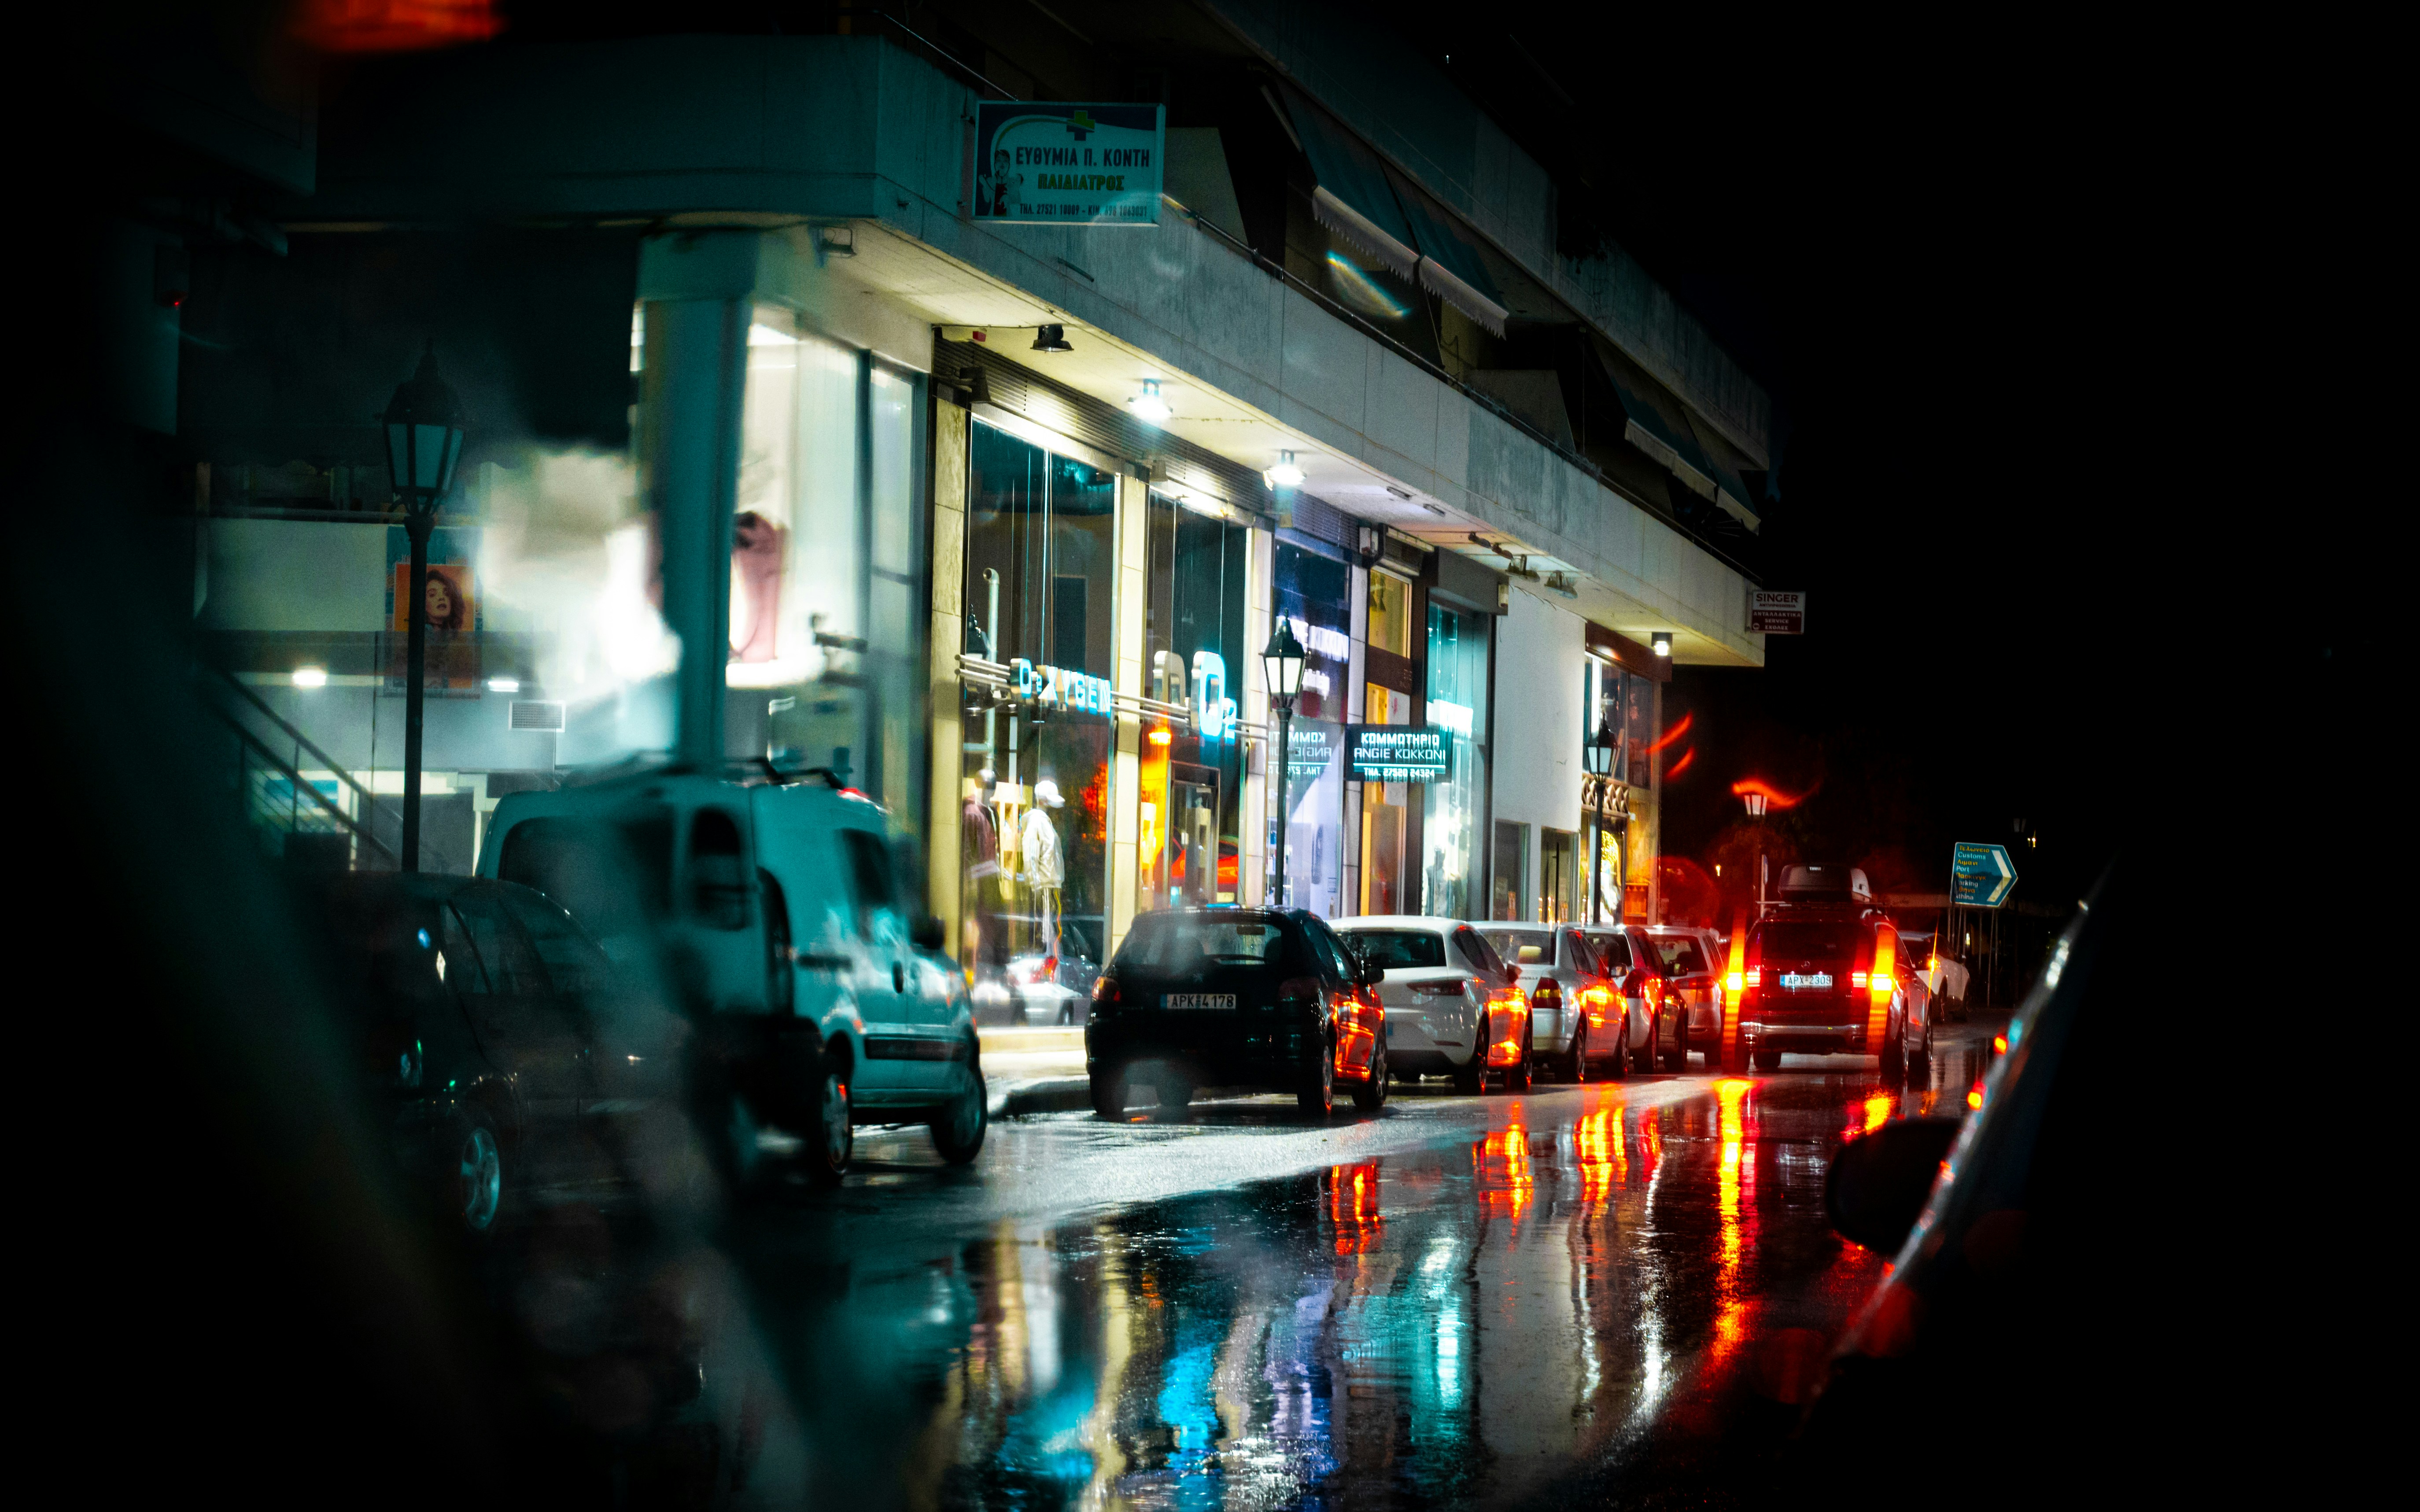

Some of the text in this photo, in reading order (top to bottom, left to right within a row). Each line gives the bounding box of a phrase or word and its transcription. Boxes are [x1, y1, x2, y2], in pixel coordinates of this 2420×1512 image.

[1016, 147, 1150, 167] ΕΥΘΥΜΙΑ Π. ΚΟΝΤΗ
[1038, 174, 1125, 191] ΠΑΙΔΙΑΤΡΟΣ
[1020, 203, 1034, 214] ΤΗΛ.
[1037, 204, 1056, 215] 27521
[1756, 593, 1799, 603] SINGER
[1354, 748, 1446, 760] ANGIE KOKKONI
[1383, 768, 1408, 777] 27520
[1410, 769, 1435, 777] 24324
